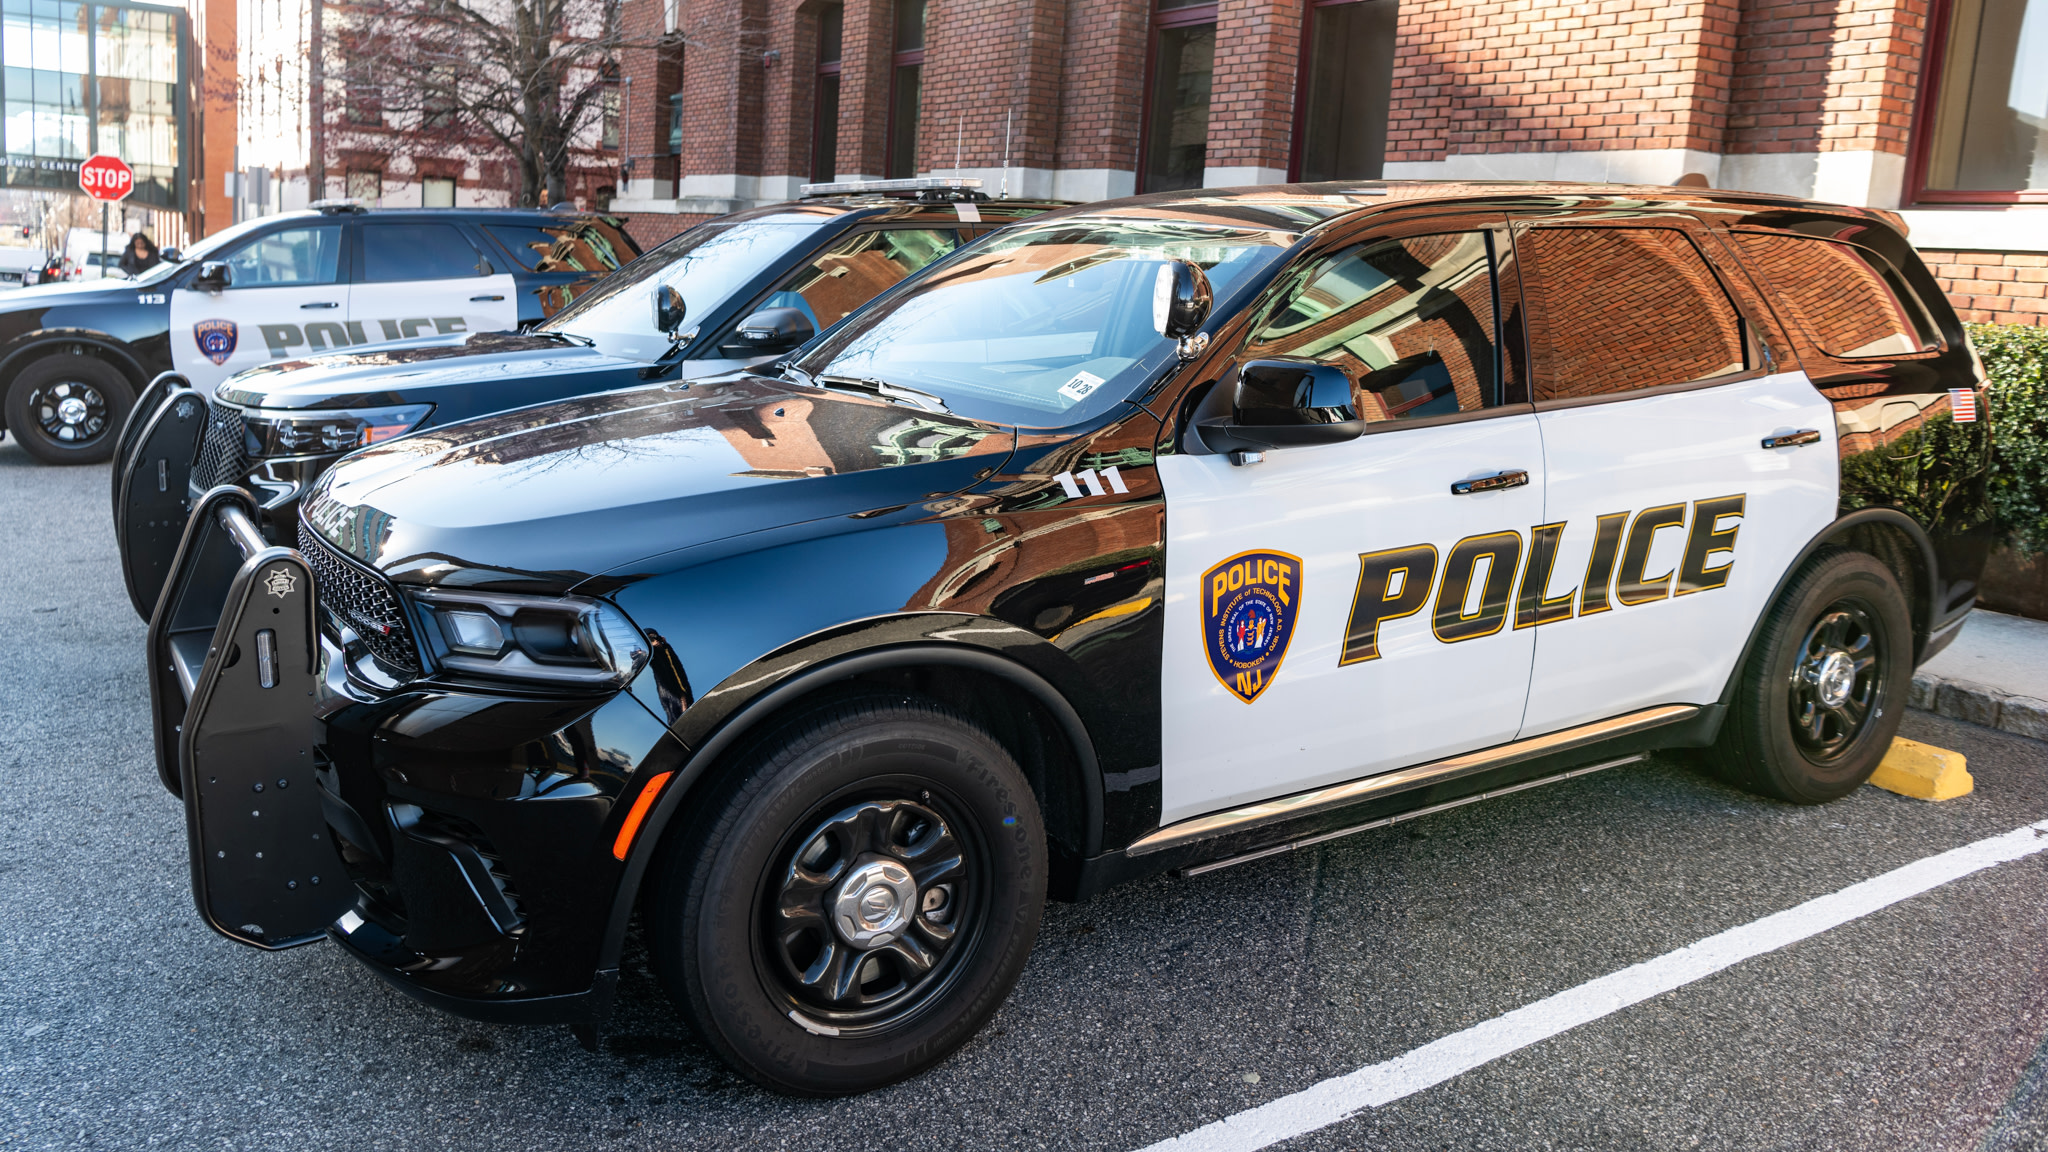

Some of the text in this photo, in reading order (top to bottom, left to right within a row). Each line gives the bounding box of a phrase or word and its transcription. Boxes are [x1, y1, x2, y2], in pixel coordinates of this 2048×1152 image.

[41, 160, 79, 172] CENTE
[83, 167, 130, 189] STOP
[138, 294, 165, 304] 113
[197, 320, 233, 338] POLICE
[1067, 379, 1092, 395] 10 28
[1052, 465, 1130, 499] 111
[307, 490, 356, 538] POLICE
[1212, 559, 1292, 618] POLICE
[1337, 493, 1746, 667] POLICE
[1220, 593, 1243, 626] INSTITUTE
[1253, 587, 1282, 616] TECHNOLOGY
[1219, 629, 1230, 661] STEVENS
[1269, 635, 1279, 651] 1870
[1233, 655, 1265, 669] HOBOKEN
[1236, 669, 1263, 696] NJ
[965, 755, 1033, 879] Firestone
[714, 942, 798, 1069] Firestone
